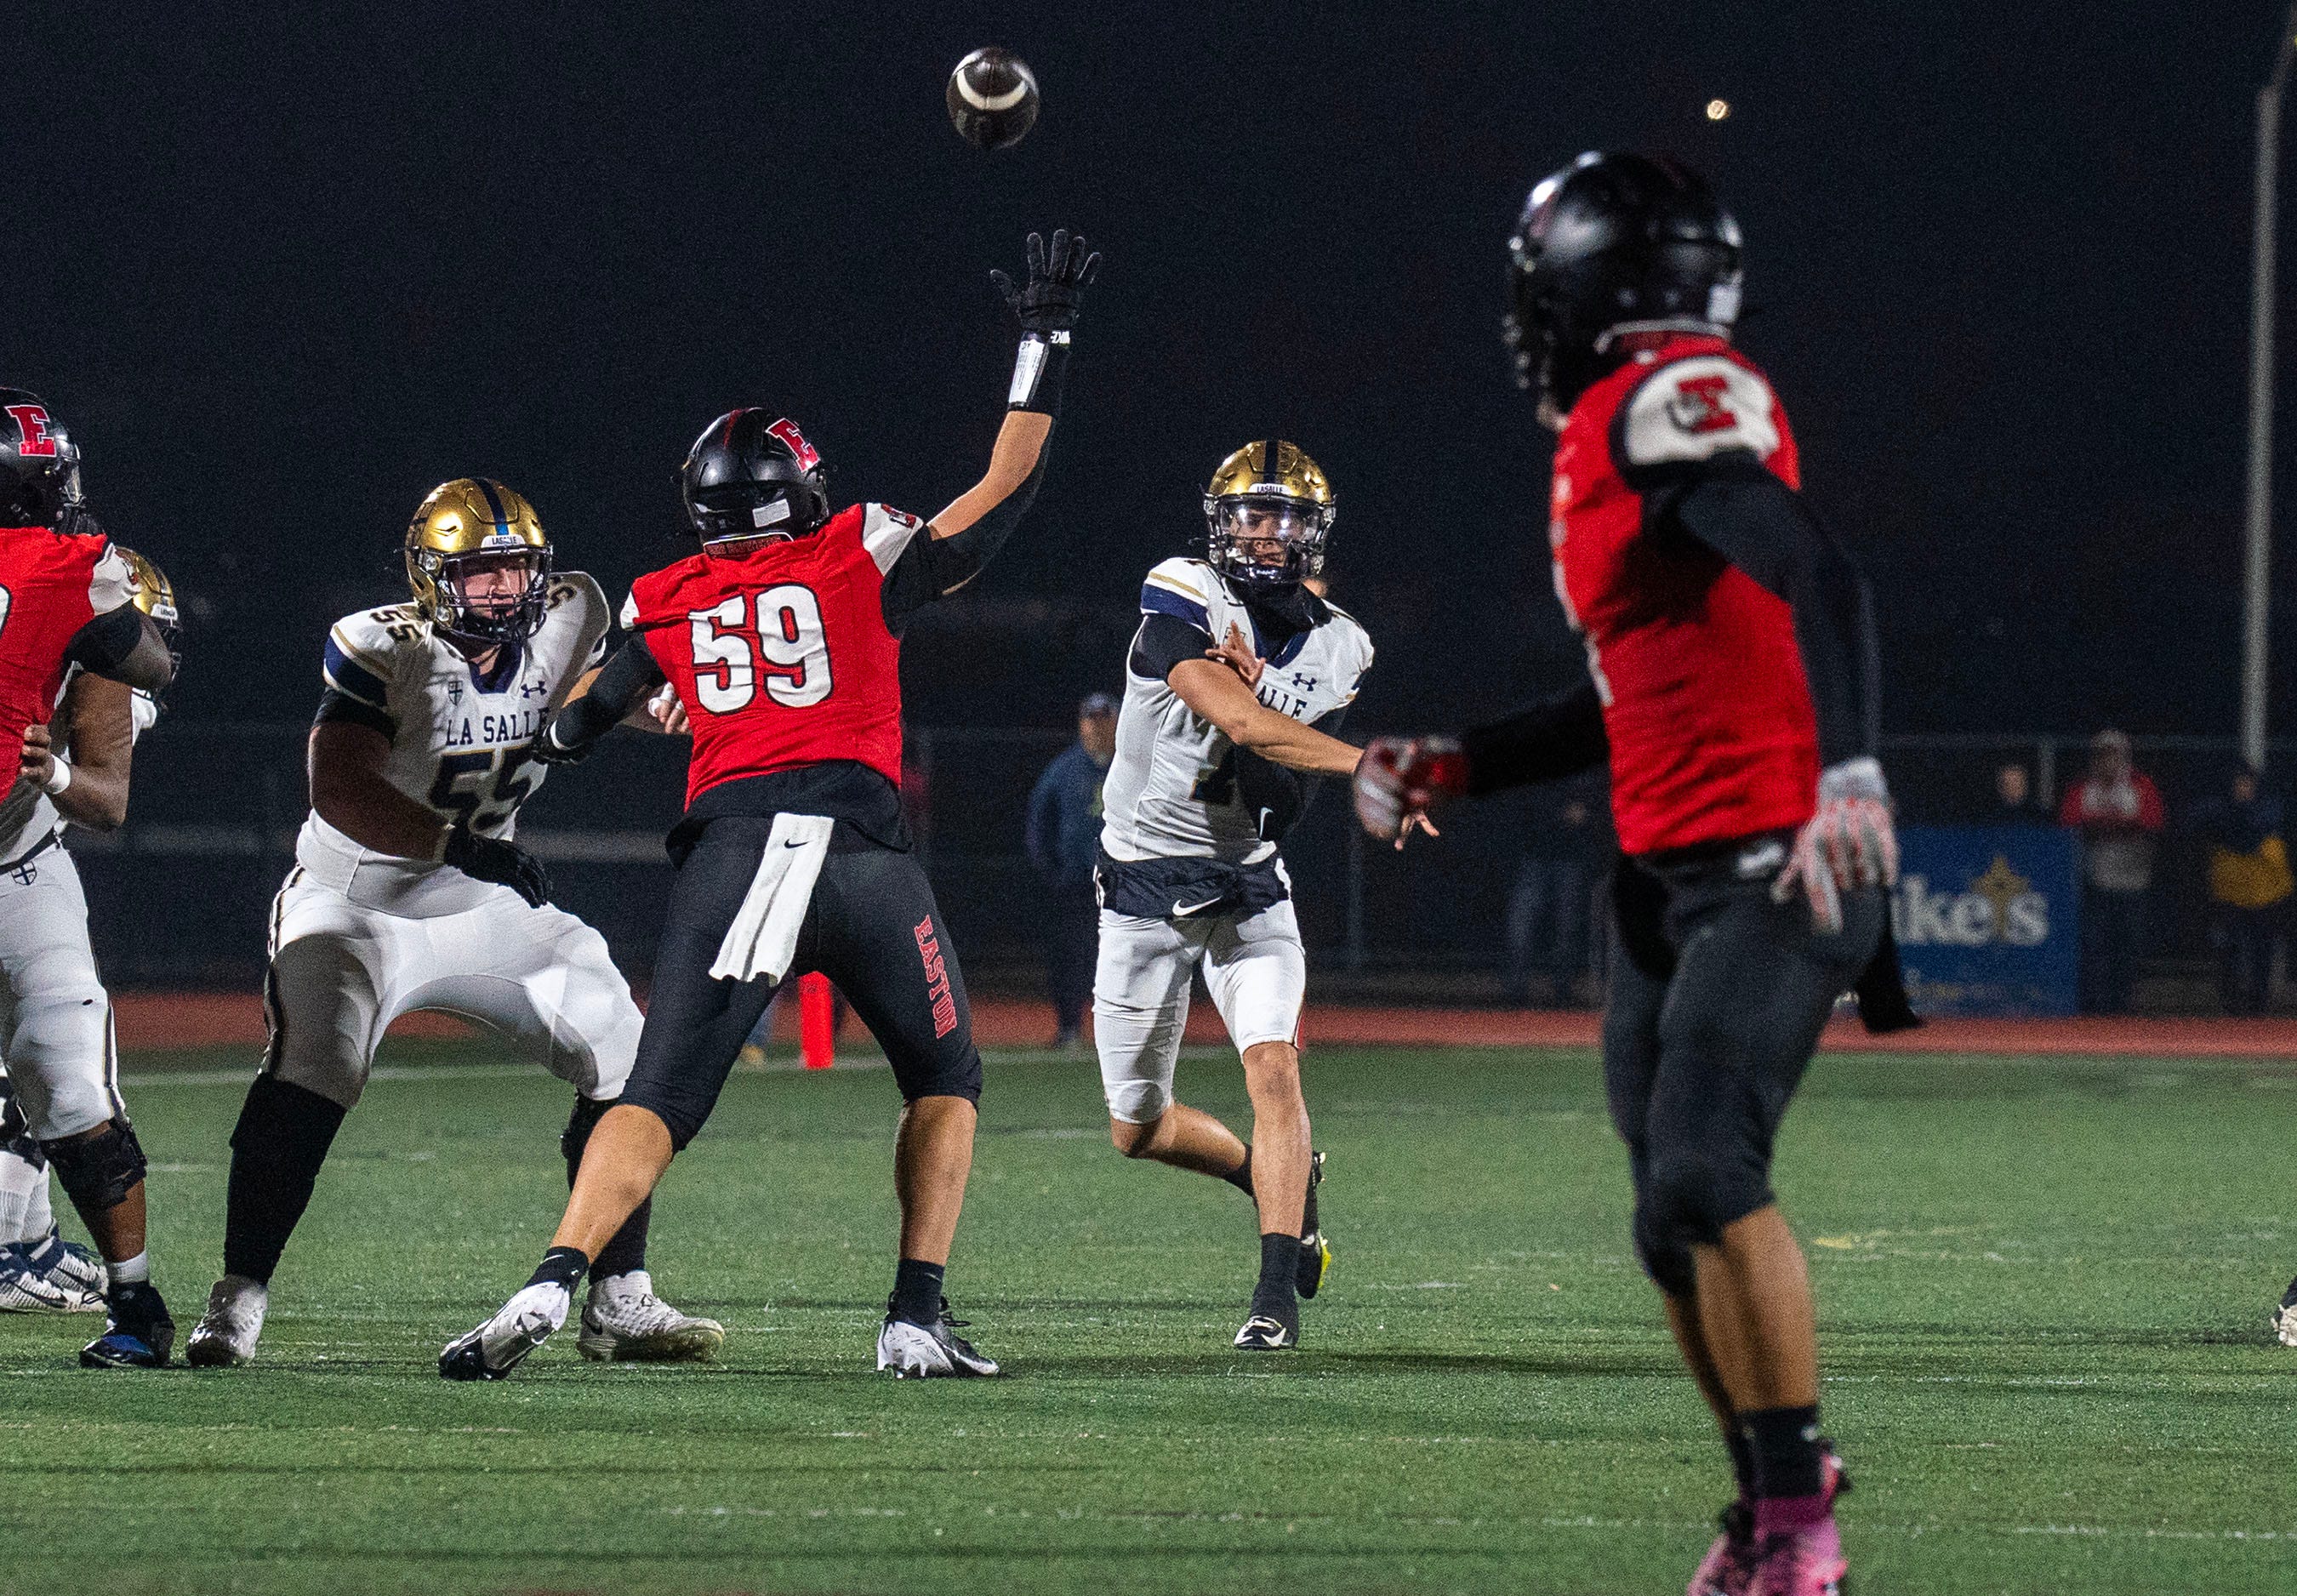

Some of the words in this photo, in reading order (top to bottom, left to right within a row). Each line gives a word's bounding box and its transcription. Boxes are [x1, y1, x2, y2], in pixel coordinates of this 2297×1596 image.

[4, 404, 57, 458] E
[765, 417, 821, 473] E
[368, 609, 424, 641] 55
[687, 582, 834, 717] 59
[446, 718, 473, 745] LA
[914, 914, 958, 1040] EASTON
